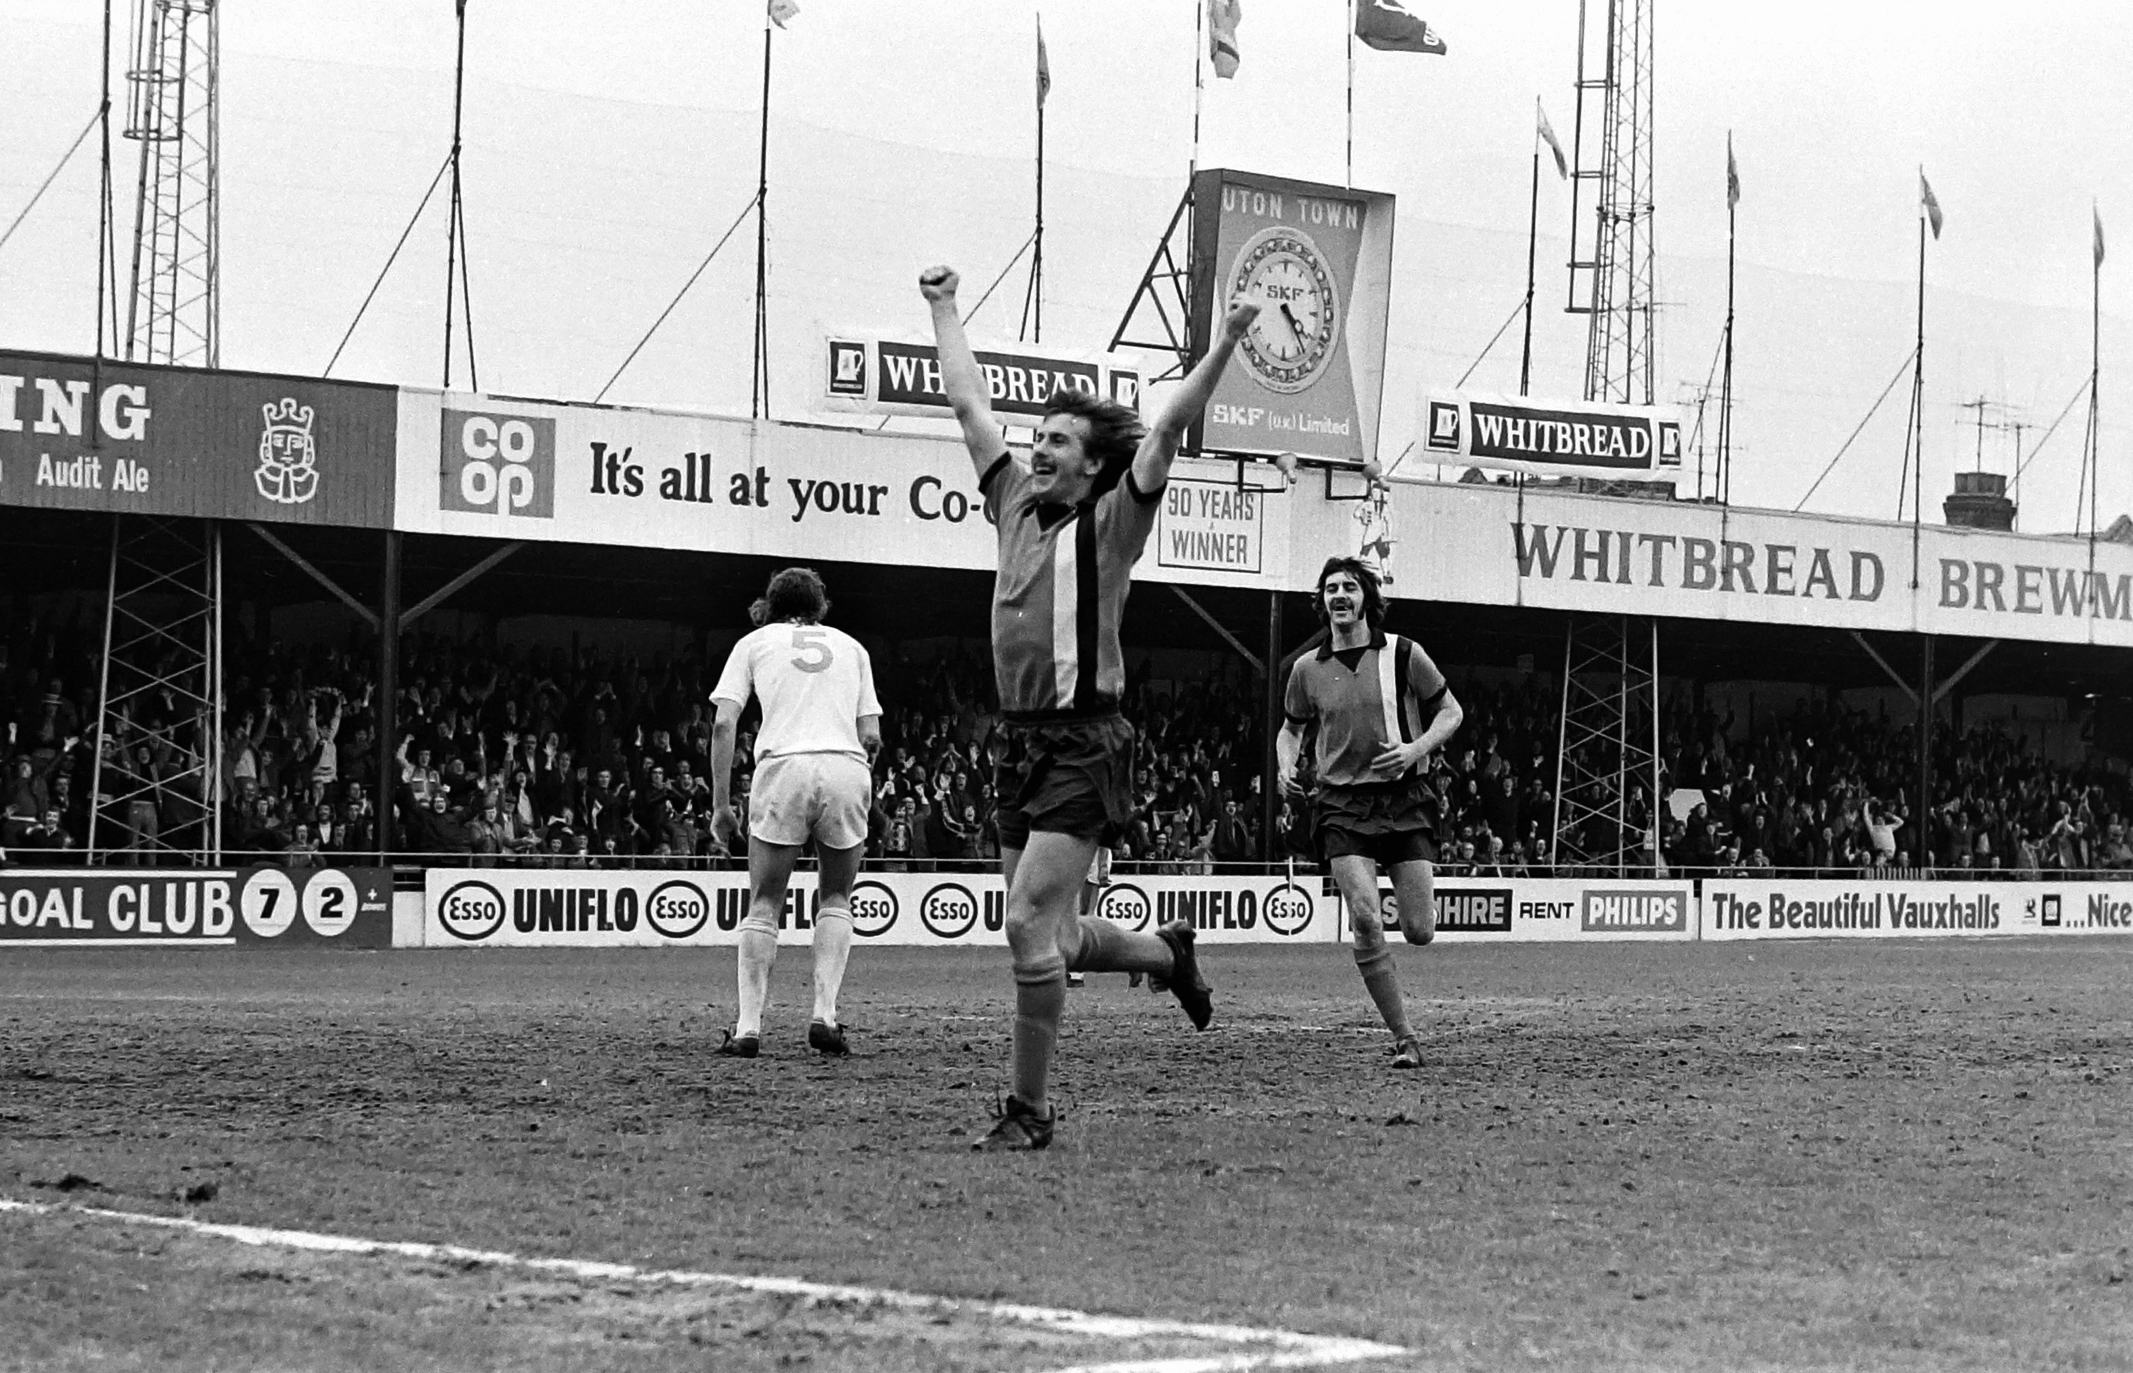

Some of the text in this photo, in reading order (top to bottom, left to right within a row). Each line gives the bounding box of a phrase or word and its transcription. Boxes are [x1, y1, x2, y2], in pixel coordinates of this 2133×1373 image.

[1298, 198, 1358, 229] TOWN
[1266, 284, 1304, 301] SKF
[883, 354, 1096, 404] WHBREAD
[0, 374, 152, 441] ING
[1213, 404, 1264, 425] SKF
[1300, 413, 1350, 436] Limited
[462, 416, 534, 463] CO
[1474, 413, 1650, 458] WHITBREAD
[36, 453, 102, 490] Audit
[112, 458, 149, 493] Ale
[590, 442, 644, 497] It's
[659, 452, 713, 503] all
[729, 466, 770, 507] at
[787, 478, 889, 523] your
[1168, 487, 1254, 521] 90 YEARS
[1171, 529, 1248, 564] WINNER
[1510, 522, 1885, 602] WHITBREAD
[1938, 558, 2132, 621] BREWM
[791, 631, 834, 673] 5
[108, 880, 234, 937] CLUB
[259, 888, 281, 918] 7
[320, 887, 344, 918] 2
[513, 888, 639, 932] UNIFLO
[1157, 890, 1257, 930] UNIFLO
[1519, 896, 1678, 926] RENT PHILIPS
[1712, 892, 1762, 930] The
[1768, 892, 1881, 930] Beautiful
[1886, 892, 2001, 930] Vauxhalls
